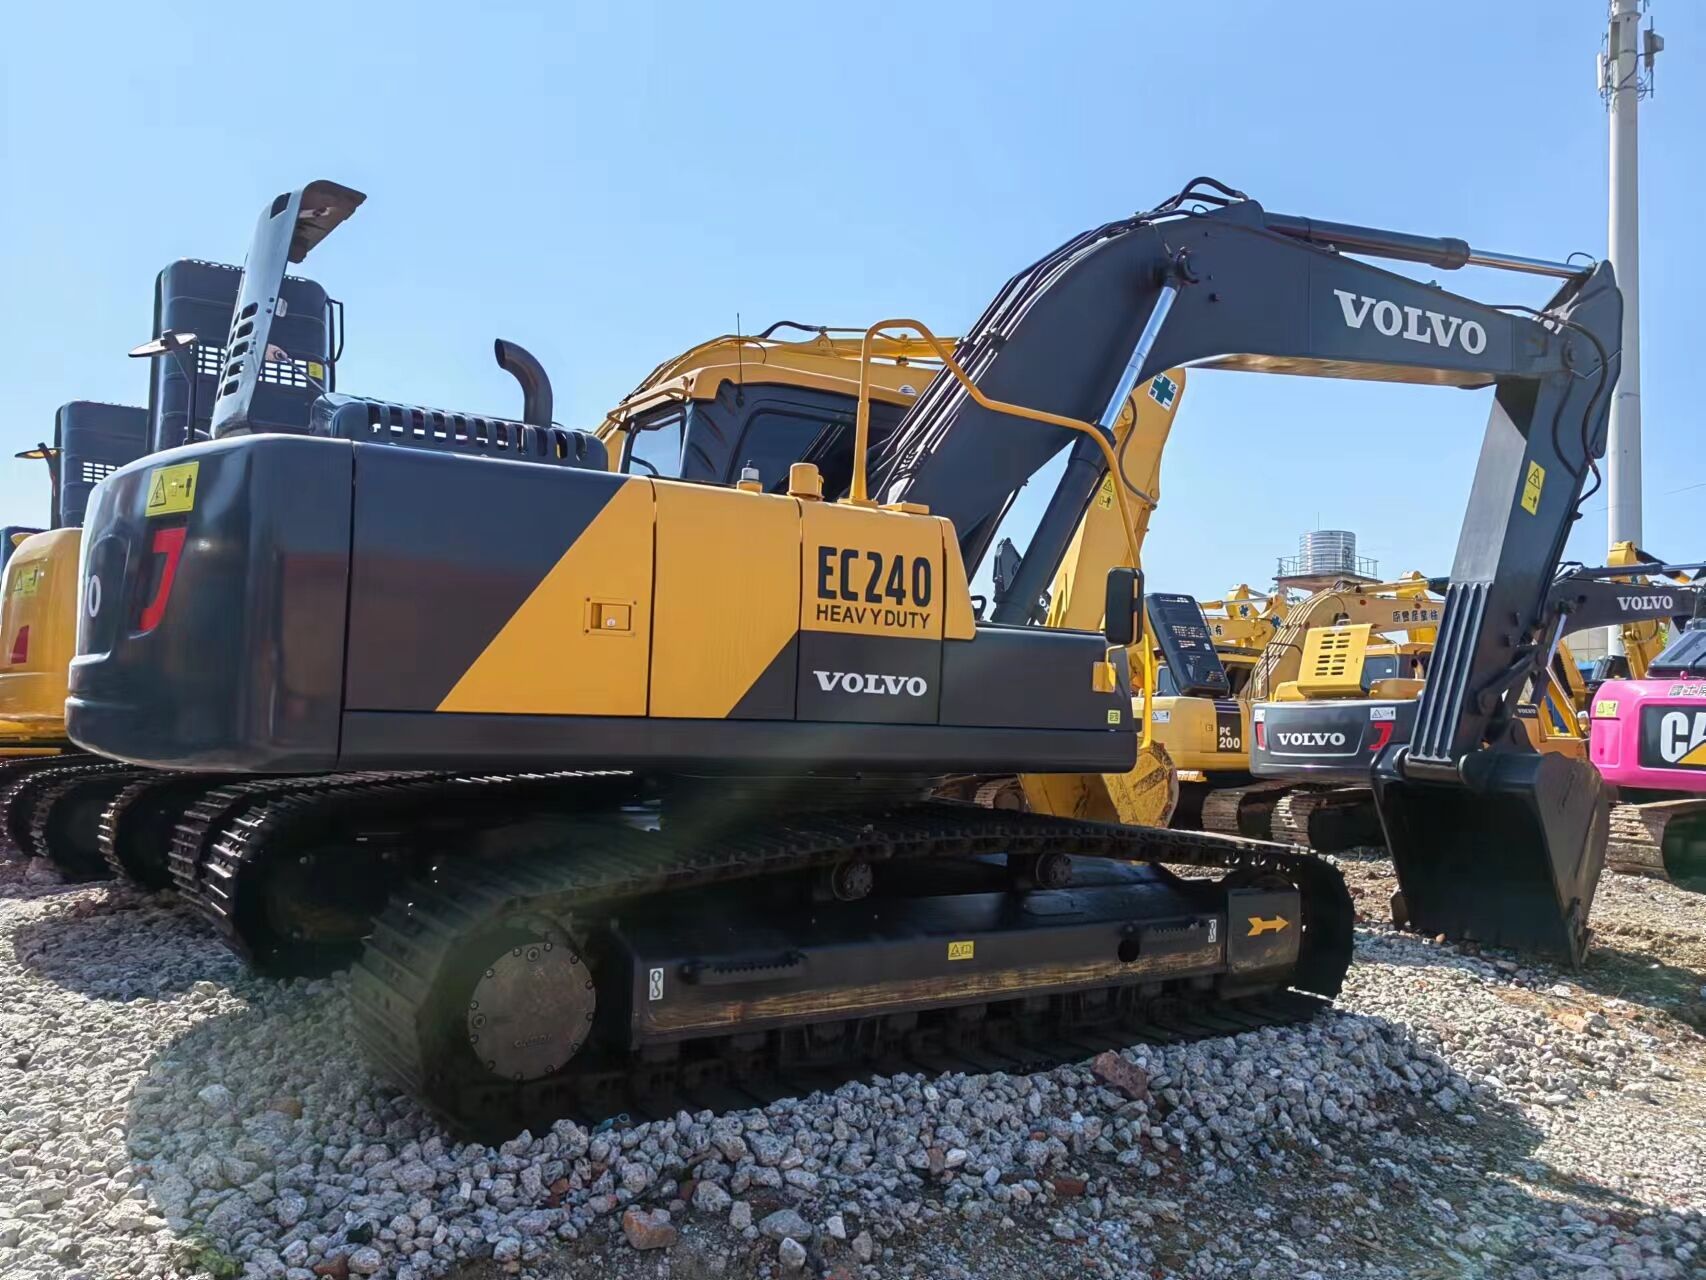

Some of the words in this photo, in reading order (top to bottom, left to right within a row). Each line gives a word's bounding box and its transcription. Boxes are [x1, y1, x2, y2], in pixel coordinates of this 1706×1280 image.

[1334, 289, 1487, 355] VOLVO
[817, 545, 932, 608] EC240
[1617, 596, 1673, 611] VOLVO
[813, 670, 927, 697] VOLVO
[1219, 726, 1231, 736] PC
[1219, 736, 1241, 749] 200
[1277, 732, 1346, 746] VOLVO
